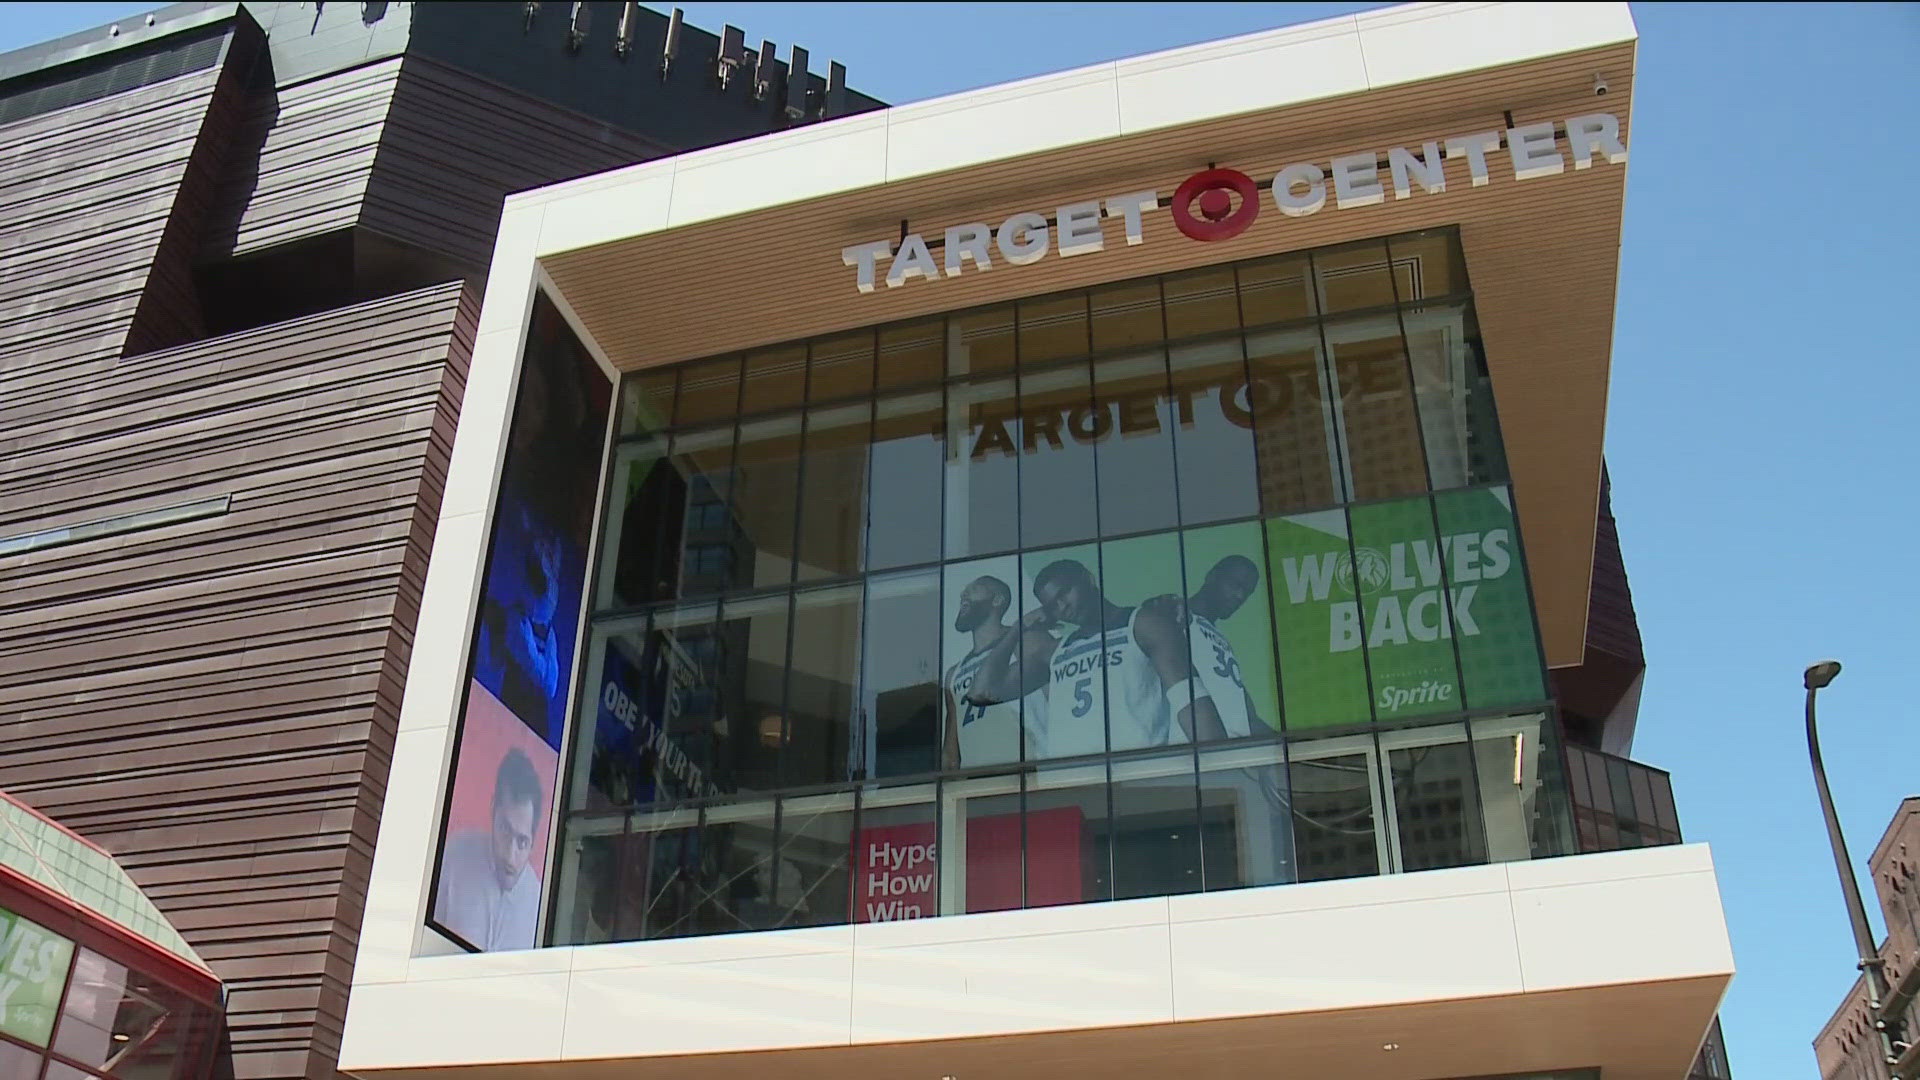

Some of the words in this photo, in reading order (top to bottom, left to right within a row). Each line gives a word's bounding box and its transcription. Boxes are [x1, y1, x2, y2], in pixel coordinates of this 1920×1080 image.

[842, 191, 1159, 293] TARGET
[1271, 113, 1627, 218] CENTER
[1329, 585, 1481, 653] BACK
[1054, 650, 1123, 683] WOLVES
[1213, 645, 1243, 688] 30
[1071, 677, 1093, 718] 5
[1379, 681, 1452, 711] Sprite
[869, 842, 937, 871] Hype
[868, 872, 933, 897] How
